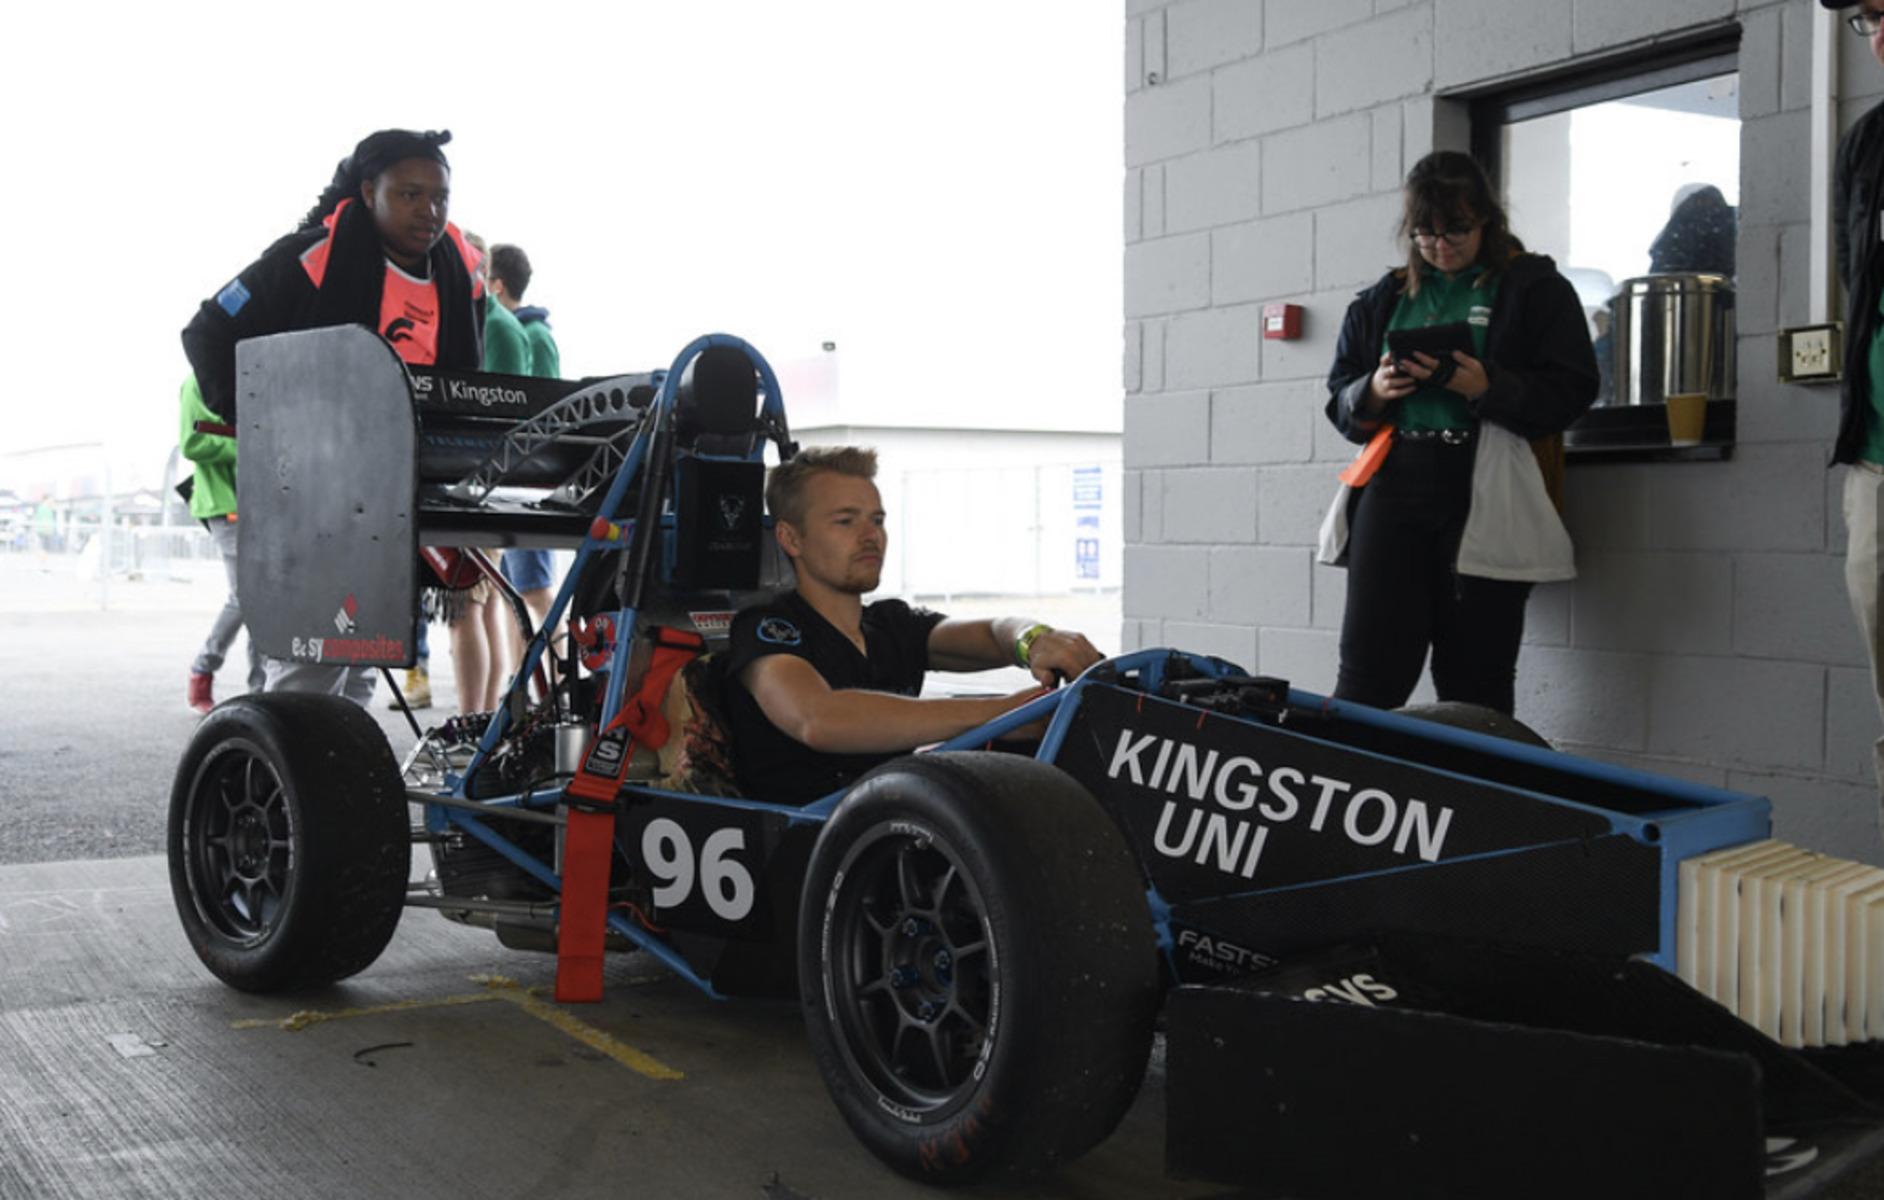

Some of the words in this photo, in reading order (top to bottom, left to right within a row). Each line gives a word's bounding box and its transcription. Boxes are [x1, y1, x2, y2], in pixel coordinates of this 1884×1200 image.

[449, 380, 528, 406] Kingston
[1107, 728, 1454, 863] KINGSTON
[641, 817, 755, 921] 96
[1154, 800, 1269, 879] UNI
[1178, 928, 1280, 972] FASTS
